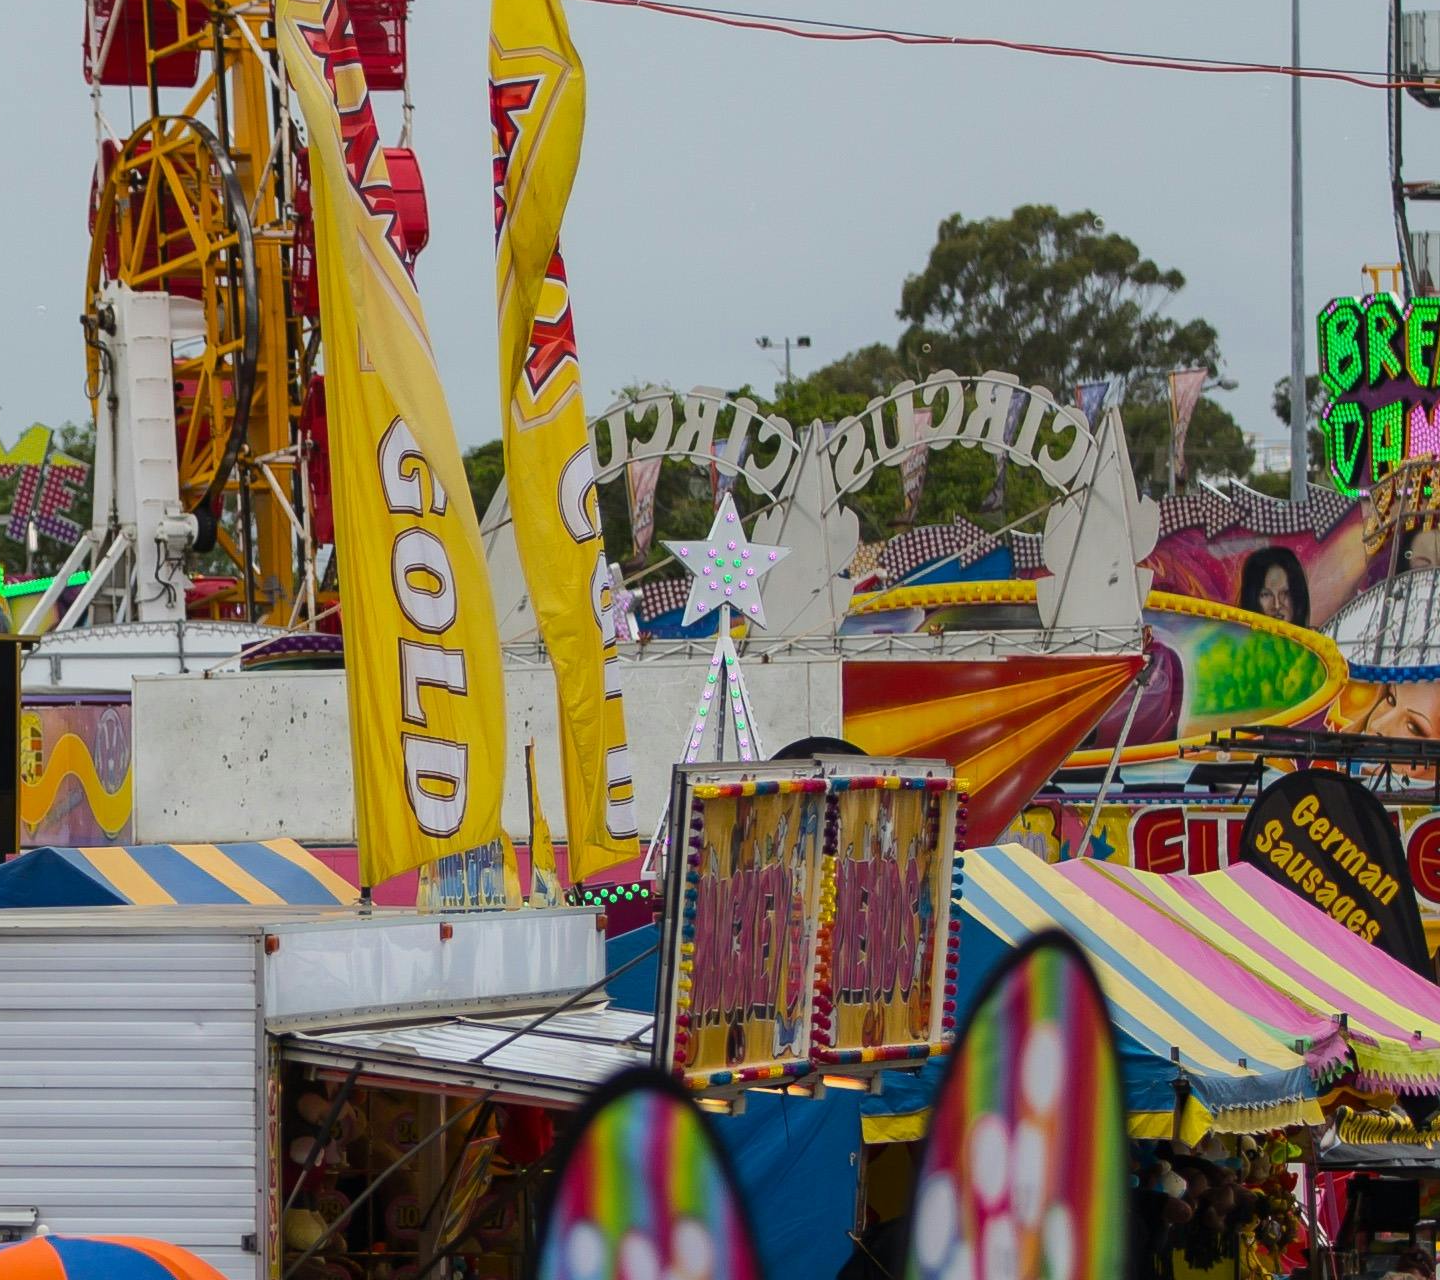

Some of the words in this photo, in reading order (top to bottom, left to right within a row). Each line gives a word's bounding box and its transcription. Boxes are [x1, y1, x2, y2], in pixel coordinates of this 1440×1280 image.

[377, 413, 469, 839] GOLD
[1255, 818, 1382, 942] Sausages
[1292, 793, 1400, 907] German
